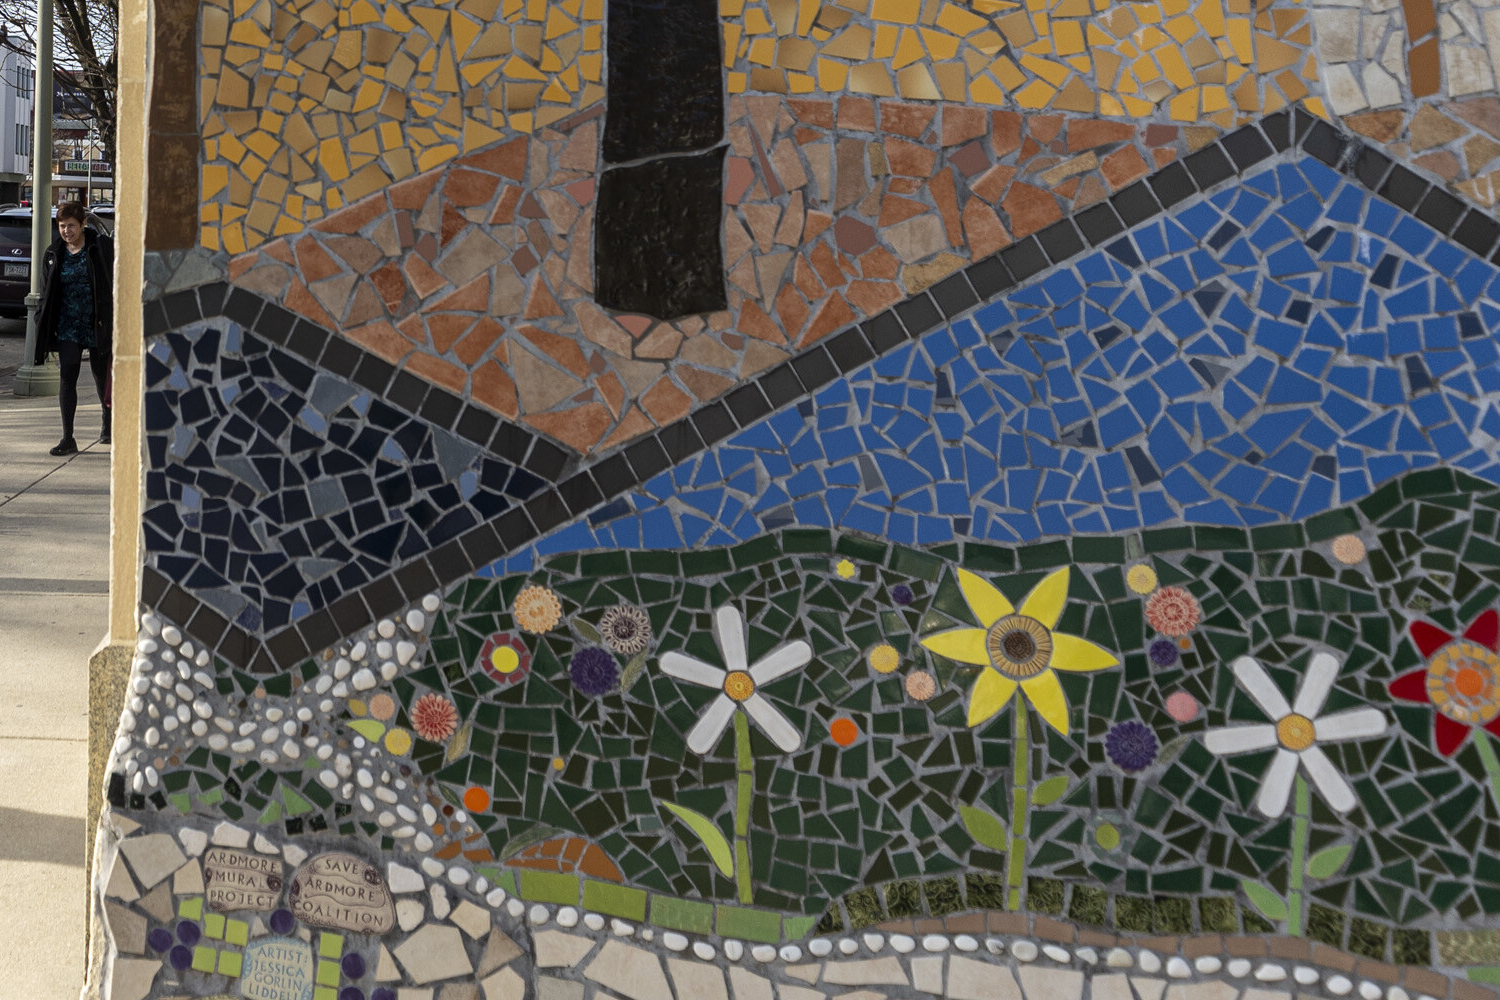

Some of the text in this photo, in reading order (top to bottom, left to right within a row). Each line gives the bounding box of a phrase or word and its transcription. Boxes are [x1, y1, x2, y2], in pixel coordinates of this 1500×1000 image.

[208, 852, 278, 873] ARDMORE
[325, 859, 359, 874] SAVE
[215, 870, 265, 888] MURAL
[210, 890, 274, 908] PROJECT
[305, 877, 375, 902] ARDMORE
[293, 899, 384, 926] COALITION
[258, 947, 308, 964] ARTIST:
[254, 960, 305, 979] JESSICA
[254, 972, 302, 991] GORLIN
